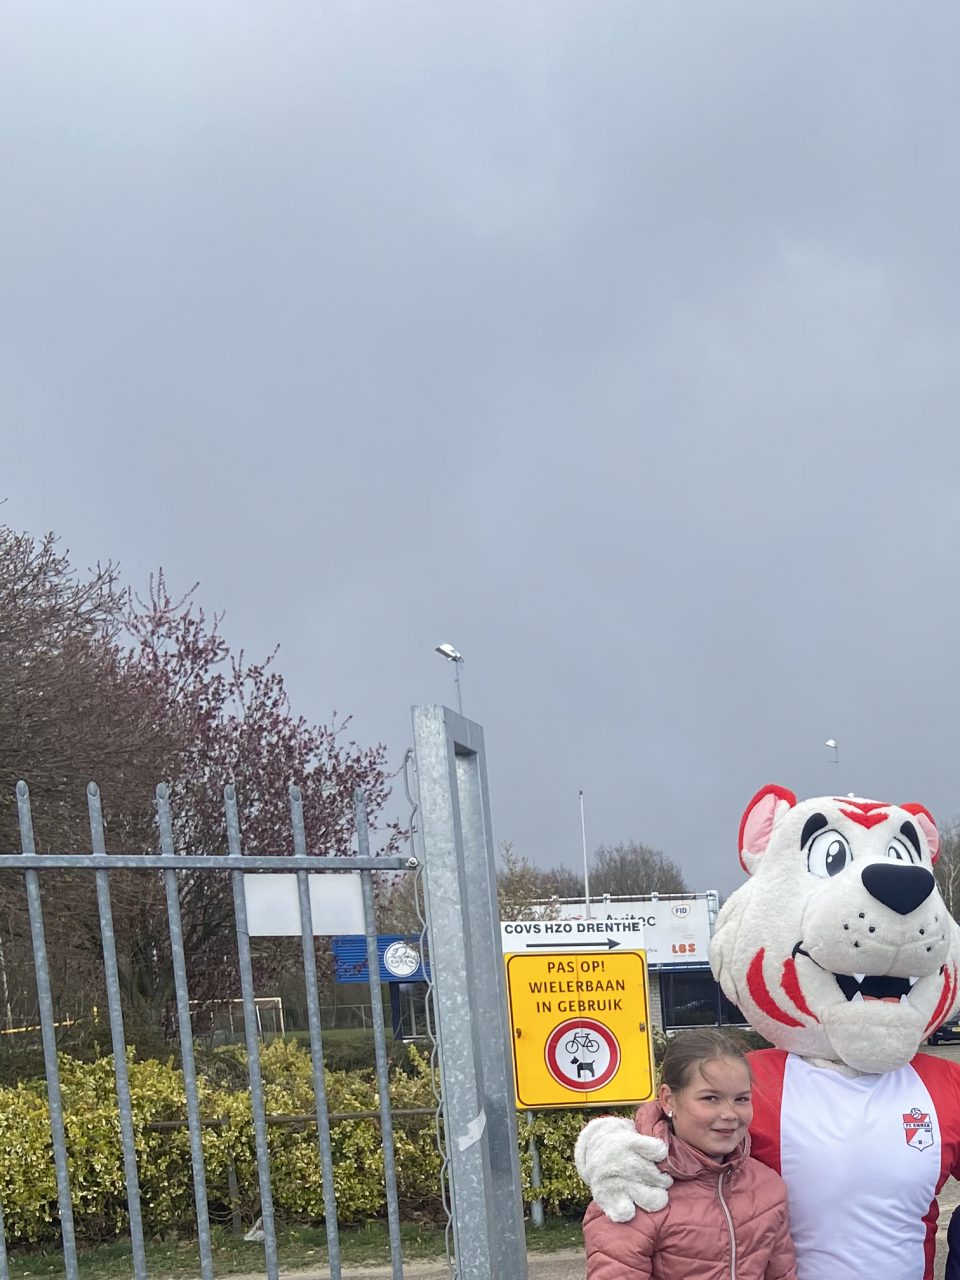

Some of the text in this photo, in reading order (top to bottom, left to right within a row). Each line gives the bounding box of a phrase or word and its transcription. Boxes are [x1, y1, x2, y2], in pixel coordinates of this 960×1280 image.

[504, 922, 641, 934] COVS HZO DRENTHE
[671, 943, 696, 954] LBS
[547, 960, 606, 974] PAS OP!
[528, 979, 626, 994] WIELERBAAN
[536, 999, 623, 1014] IN GEBRUIK
